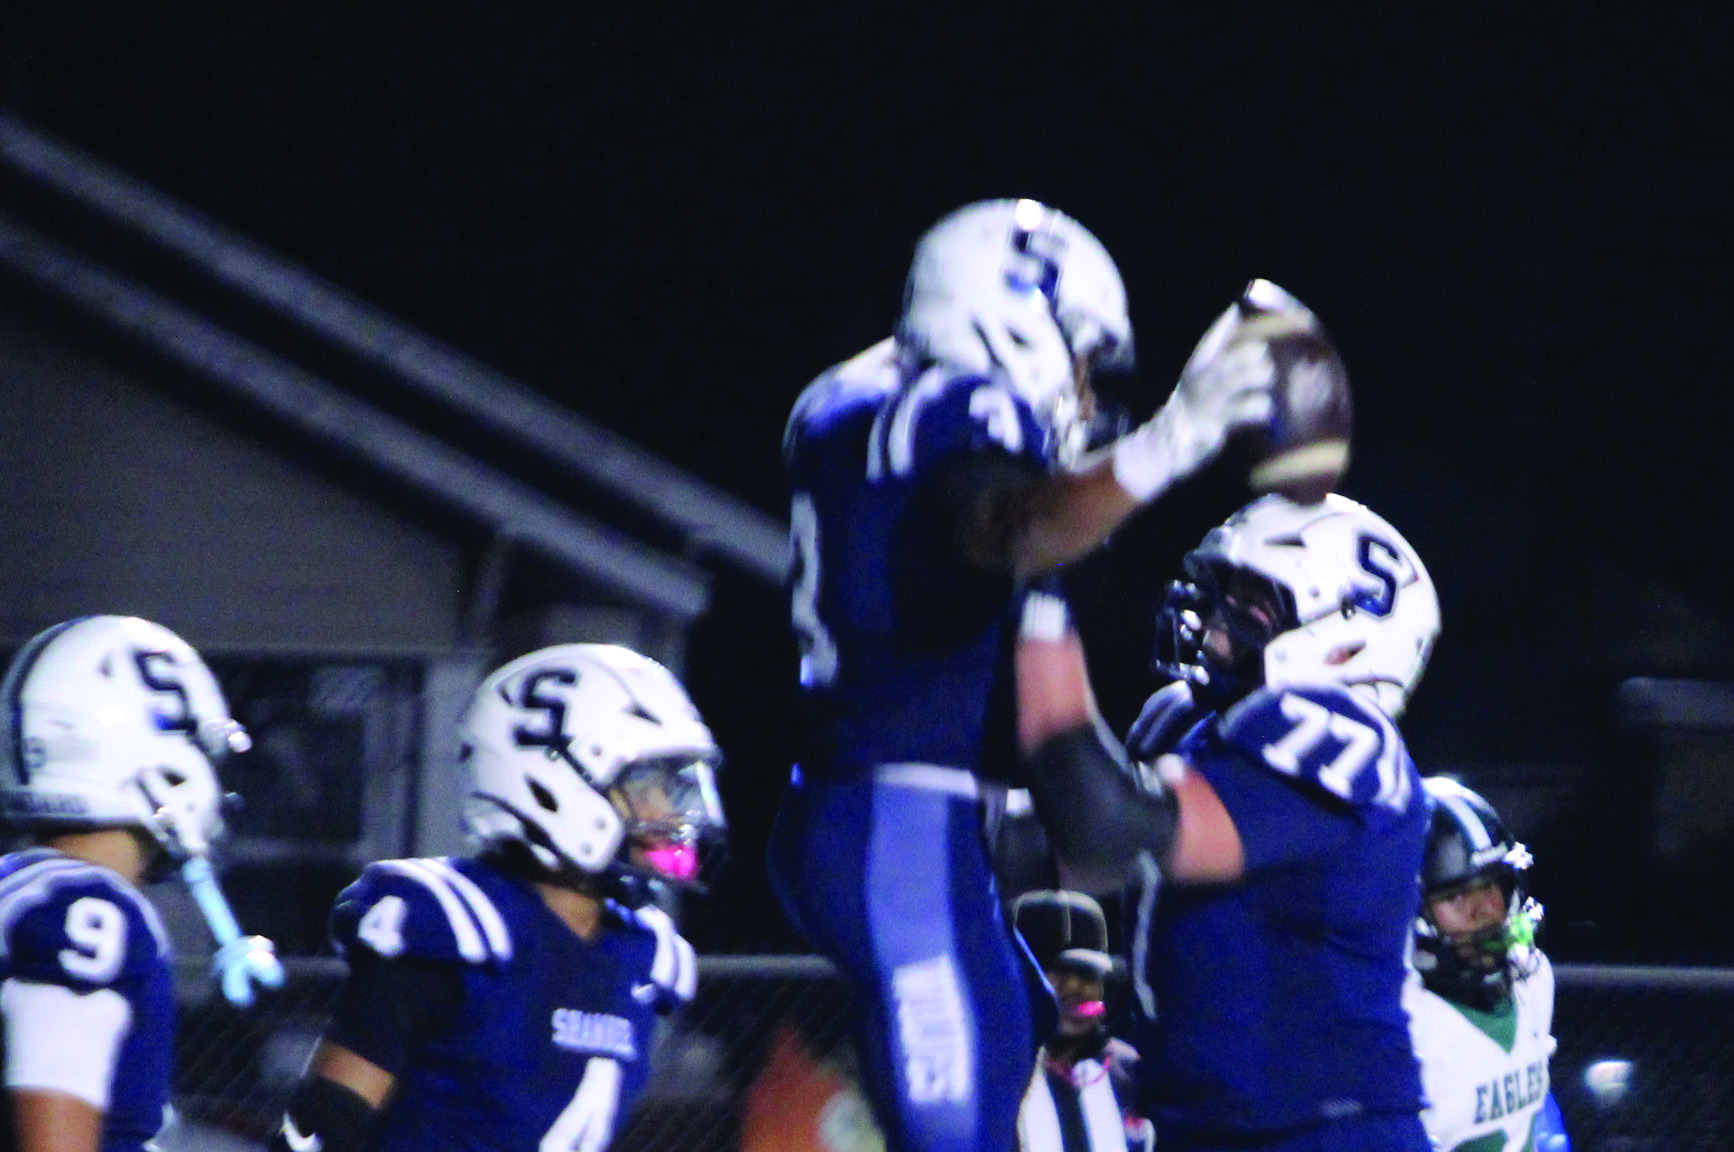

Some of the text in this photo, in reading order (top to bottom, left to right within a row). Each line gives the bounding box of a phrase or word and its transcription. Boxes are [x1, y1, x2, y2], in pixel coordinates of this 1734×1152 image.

[1352, 532, 1400, 618] S
[133, 648, 198, 734] S
[513, 668, 577, 747] S
[1261, 690, 1380, 800] 77
[60, 897, 127, 983] 9
[358, 895, 406, 958] 4
